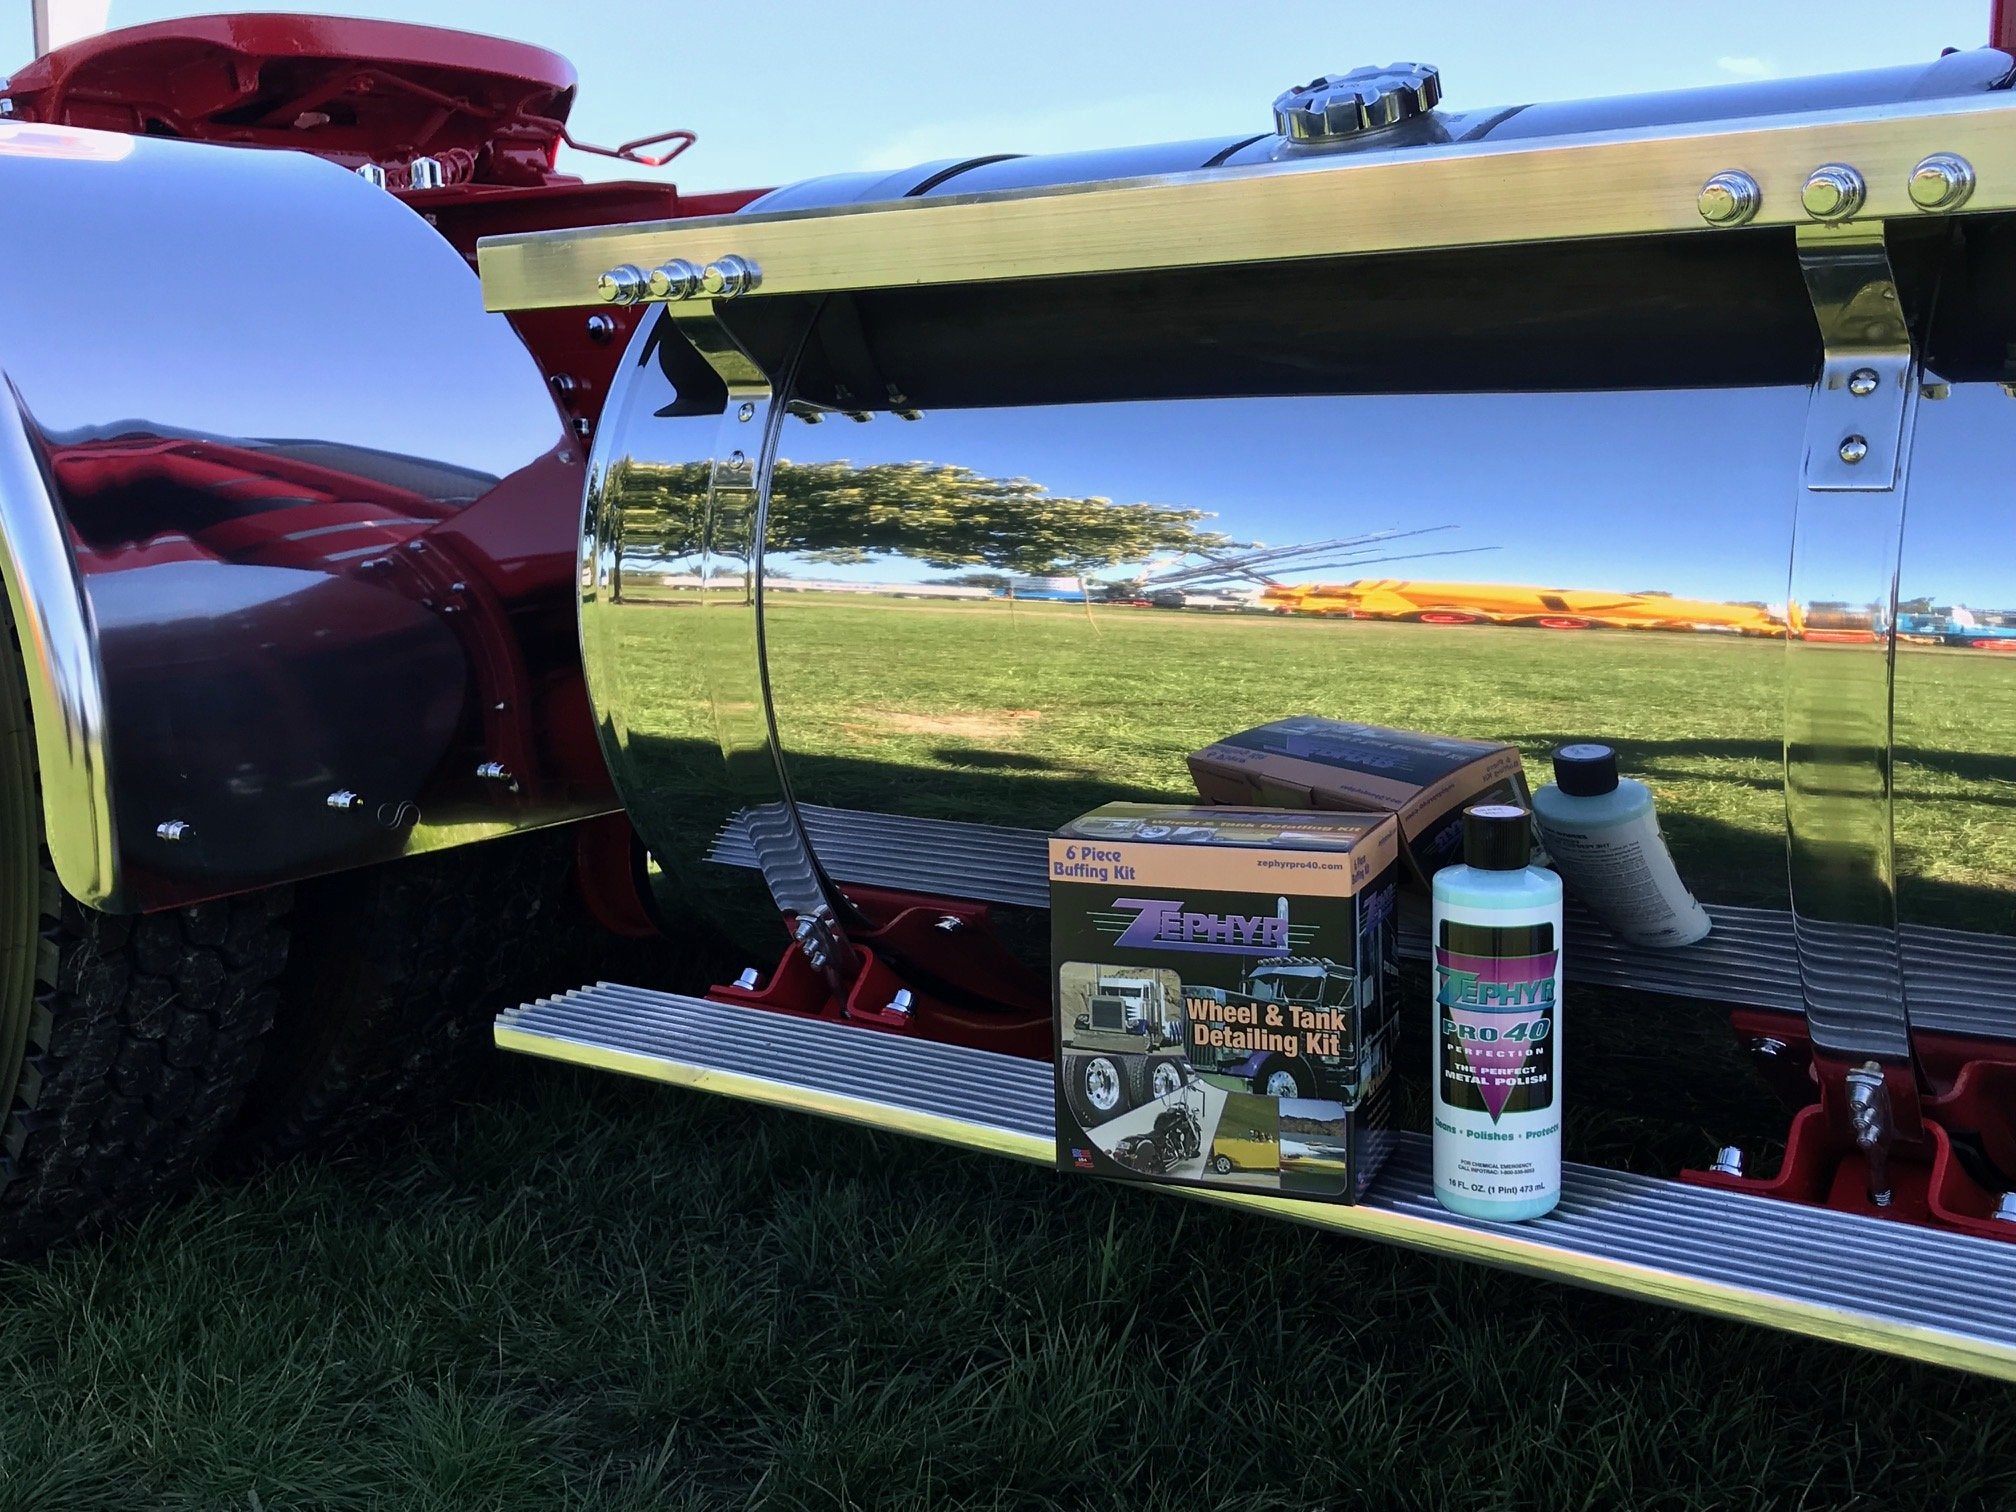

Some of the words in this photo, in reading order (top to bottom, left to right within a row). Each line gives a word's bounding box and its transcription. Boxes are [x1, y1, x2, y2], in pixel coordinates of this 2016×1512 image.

[1065, 845, 1076, 860] 6
[1081, 846, 1122, 863] Piece
[1053, 862, 1109, 882] Buffing
[1114, 865, 1136, 880] Kit
[1256, 858, 1343, 871] zephyrpro40.com
[1111, 897, 1293, 957] ZEPHYR
[1435, 964, 1557, 1015] ZEPHYR
[1186, 997, 1258, 1025] Wheel
[1265, 1004, 1284, 1027] &
[1289, 1005, 1347, 1032] Tank
[1442, 1017, 1498, 1043] PRO
[1502, 1017, 1552, 1043] 40
[1194, 1024, 1298, 1058] Detailing
[1306, 1032, 1342, 1057] Kit
[1447, 1043, 1544, 1058] PERFECTION
[1454, 1062, 1477, 1074] THE
[1480, 1065, 1537, 1075] PERFECT
[1444, 1069, 1490, 1086] METAL
[1494, 1073, 1548, 1086] POLISH
[1466, 1129, 1514, 1141] Polishes
[1472, 1161, 1499, 1169] CHEMICAL
[1448, 1178, 1457, 1187] 16
[1471, 1183, 1485, 1193] OZ.
[1498, 1185, 1518, 1195] Pint)
[1519, 1184, 1534, 1194] 473
[1534, 1182, 1546, 1191] mL
